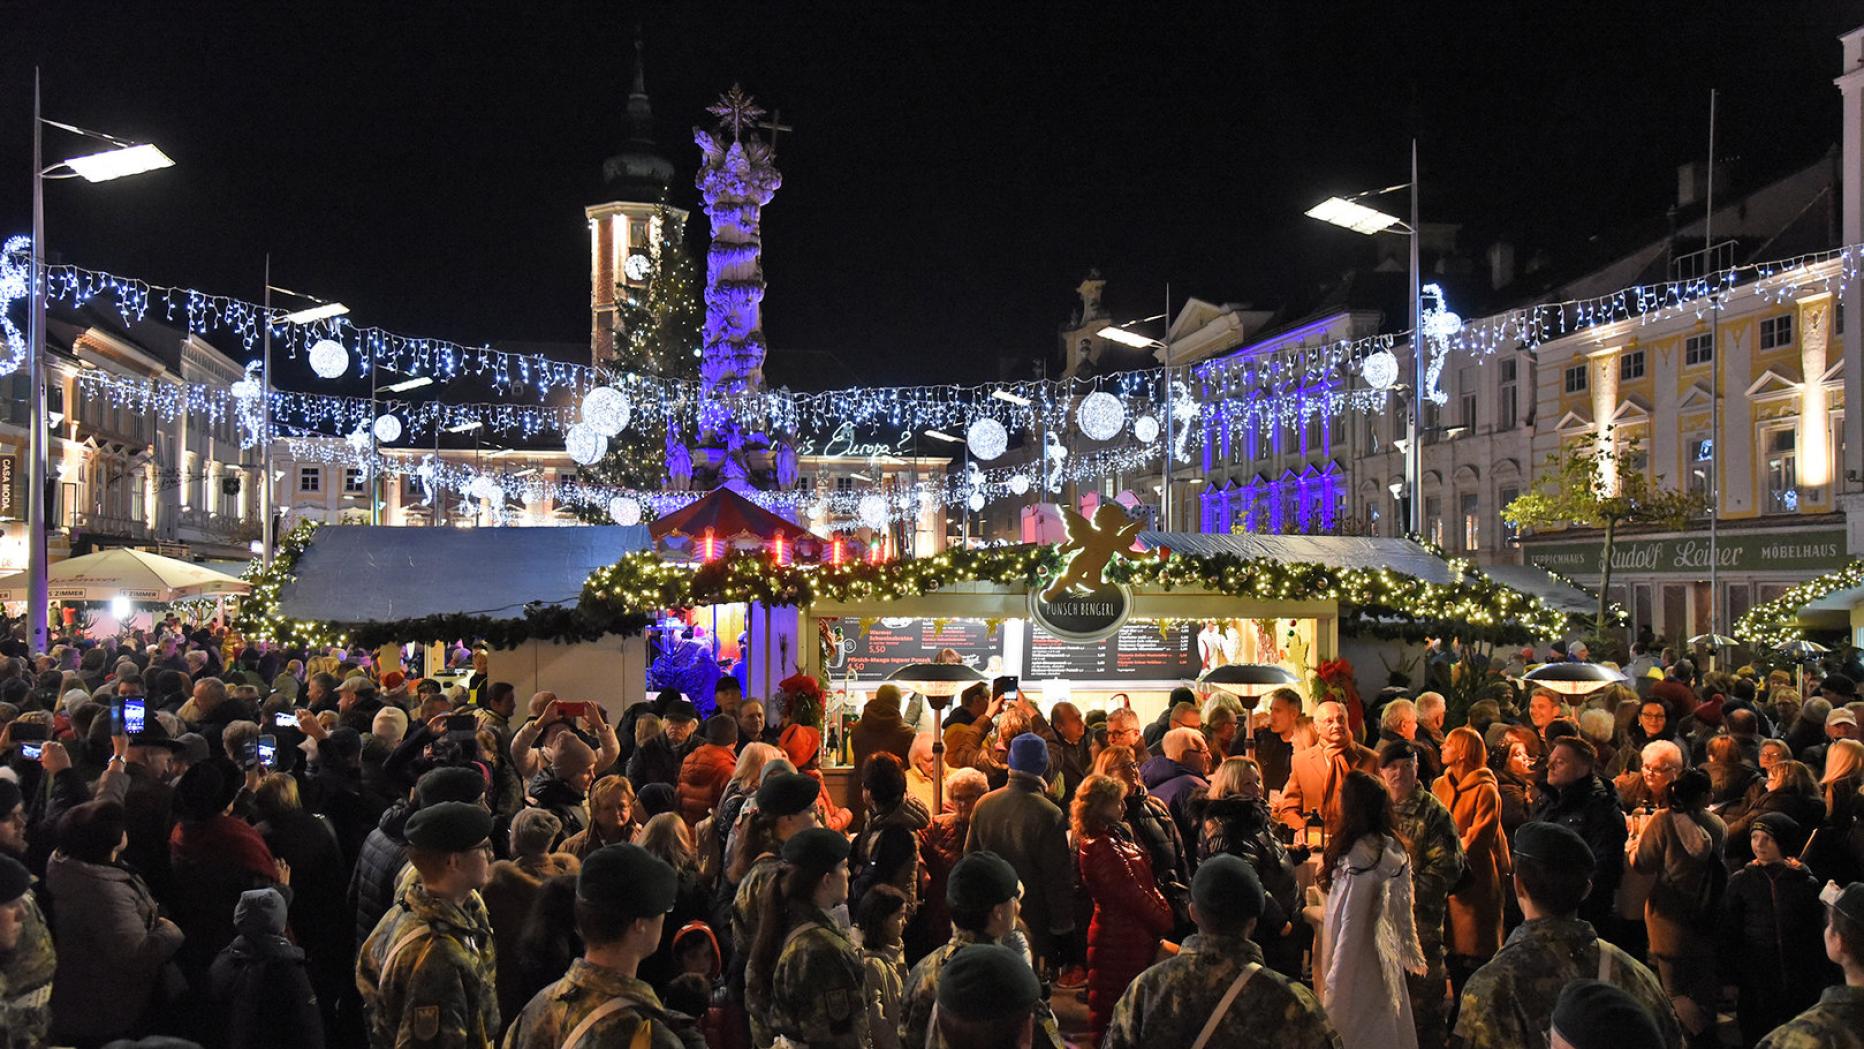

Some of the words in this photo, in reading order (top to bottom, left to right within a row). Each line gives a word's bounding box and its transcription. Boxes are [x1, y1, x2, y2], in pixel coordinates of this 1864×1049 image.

[824, 421, 912, 466] Europa?
[2, 459, 11, 483] CASA
[2, 484, 11, 511] MODA
[1531, 553, 1585, 564] TEPPICHHAUS
[1598, 542, 1663, 570] Rudolf
[1761, 543, 1837, 560] MÖBELHAUS
[1046, 602, 1078, 616] PUNSCH
[1081, 602, 1114, 616] BENGERL
